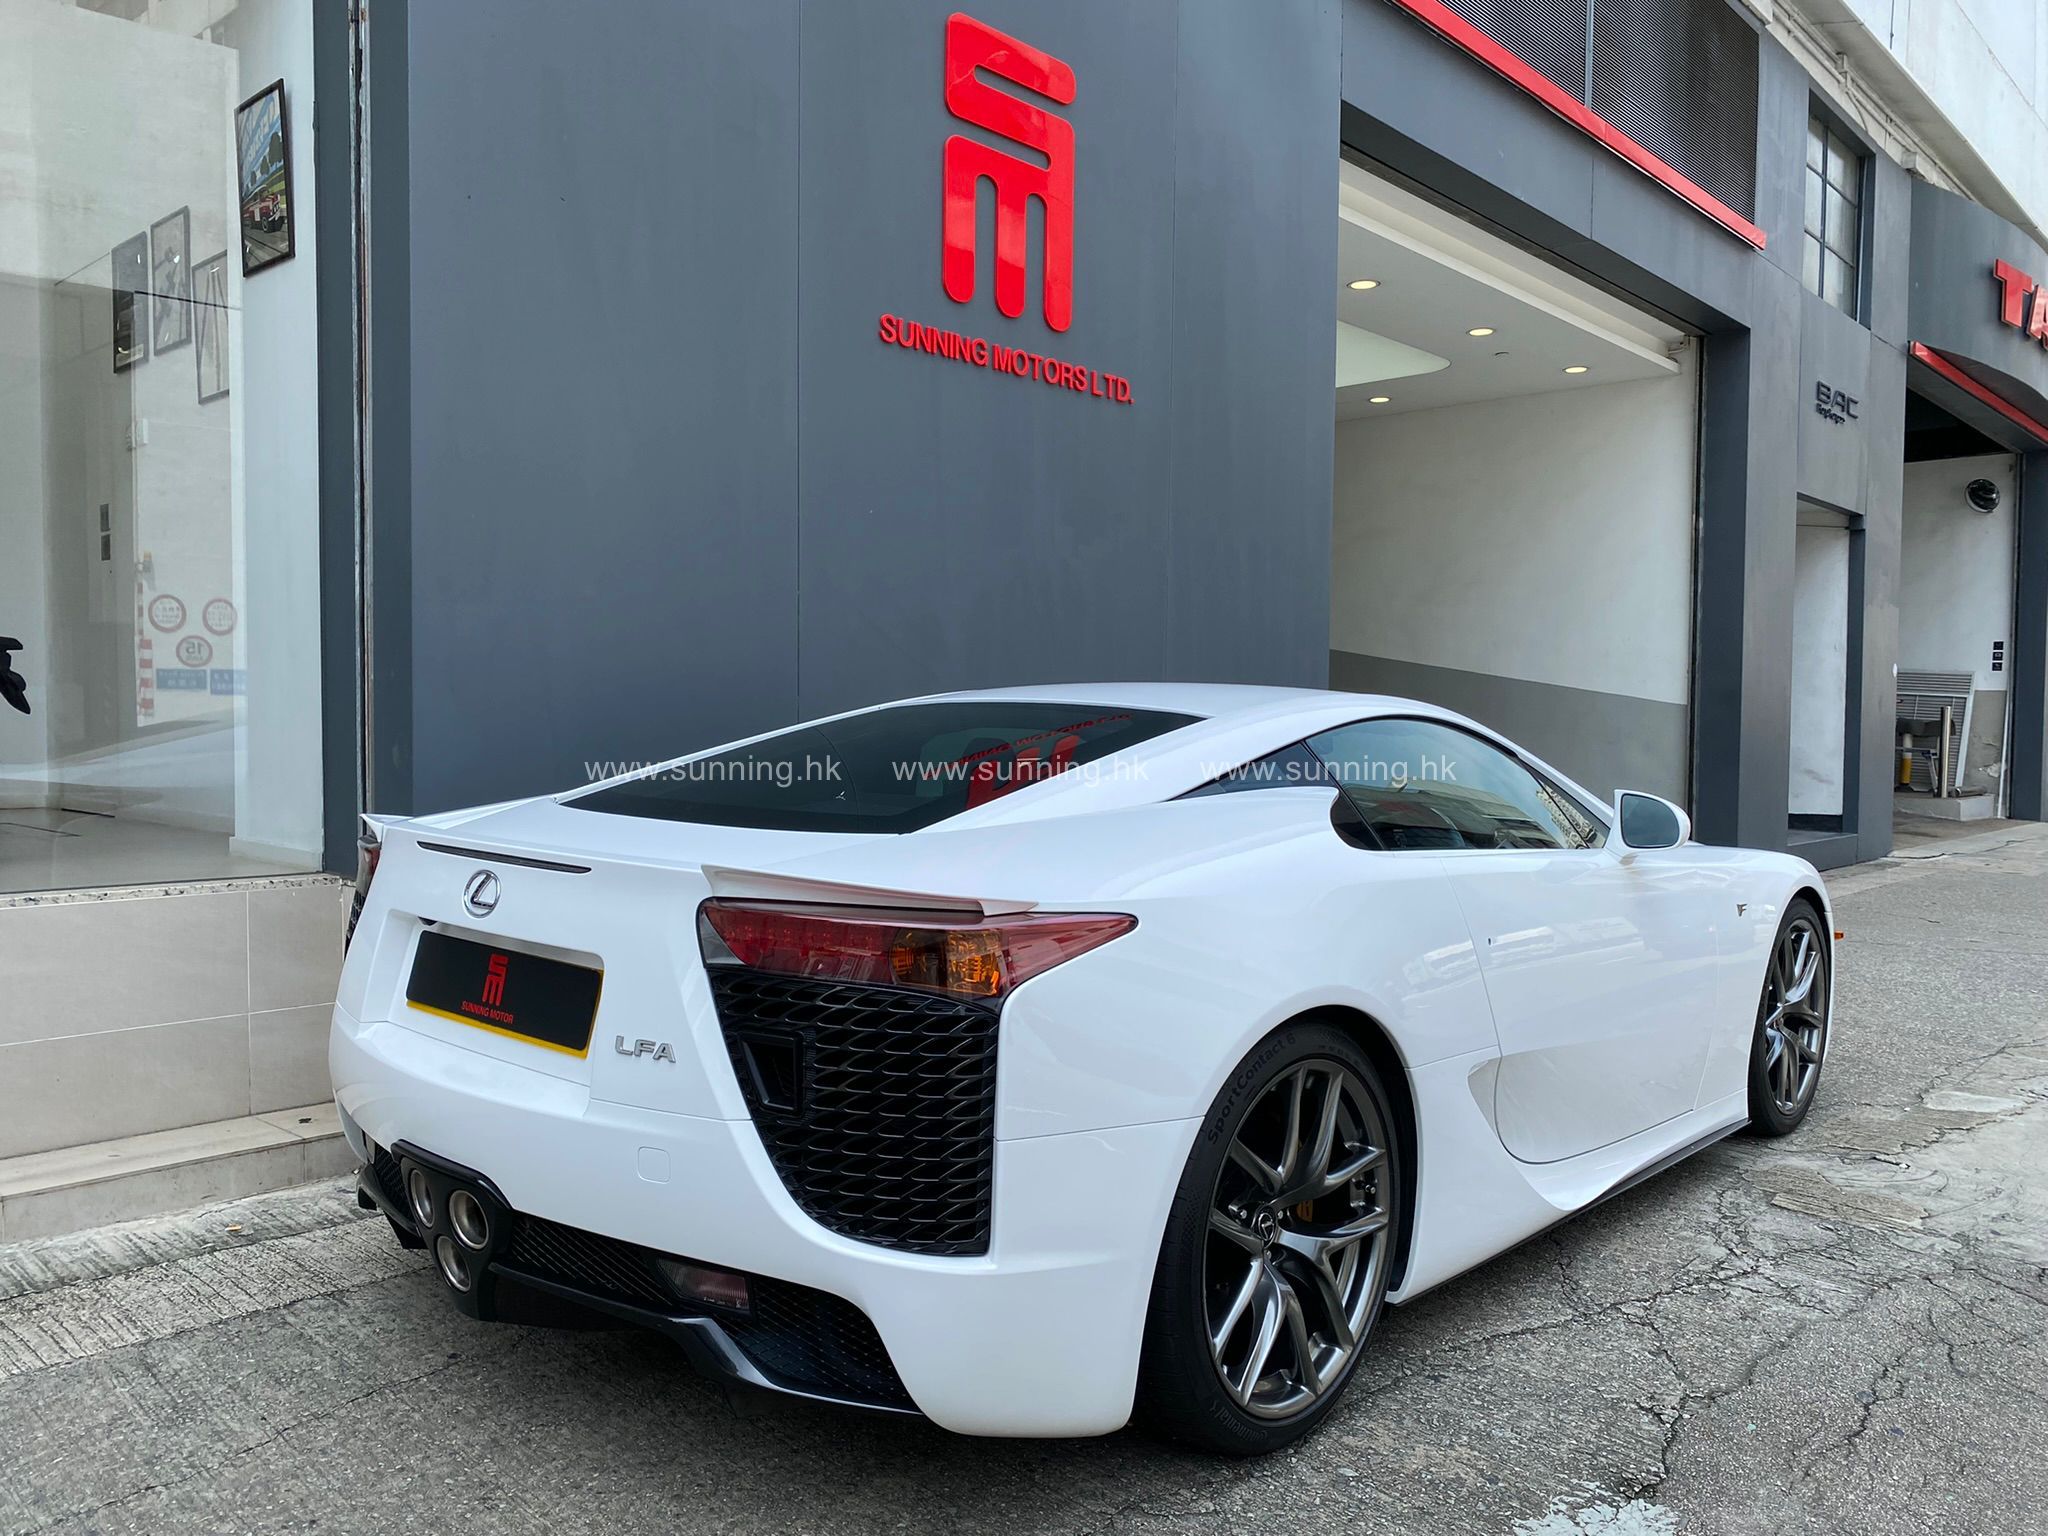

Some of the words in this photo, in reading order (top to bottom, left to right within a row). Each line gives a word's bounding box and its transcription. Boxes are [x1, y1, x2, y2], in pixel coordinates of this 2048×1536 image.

[879, 313, 988, 366] SUNNING
[992, 344, 1088, 392] MOTORS
[1090, 370, 1135, 404] LTD.
[1816, 380, 1859, 420] BAC
[461, 1000, 490, 1017] SUNNING
[490, 1009, 514, 1025] MOTOR
[615, 1035, 676, 1063] LFA
[1207, 1037, 1287, 1145] SportContact
